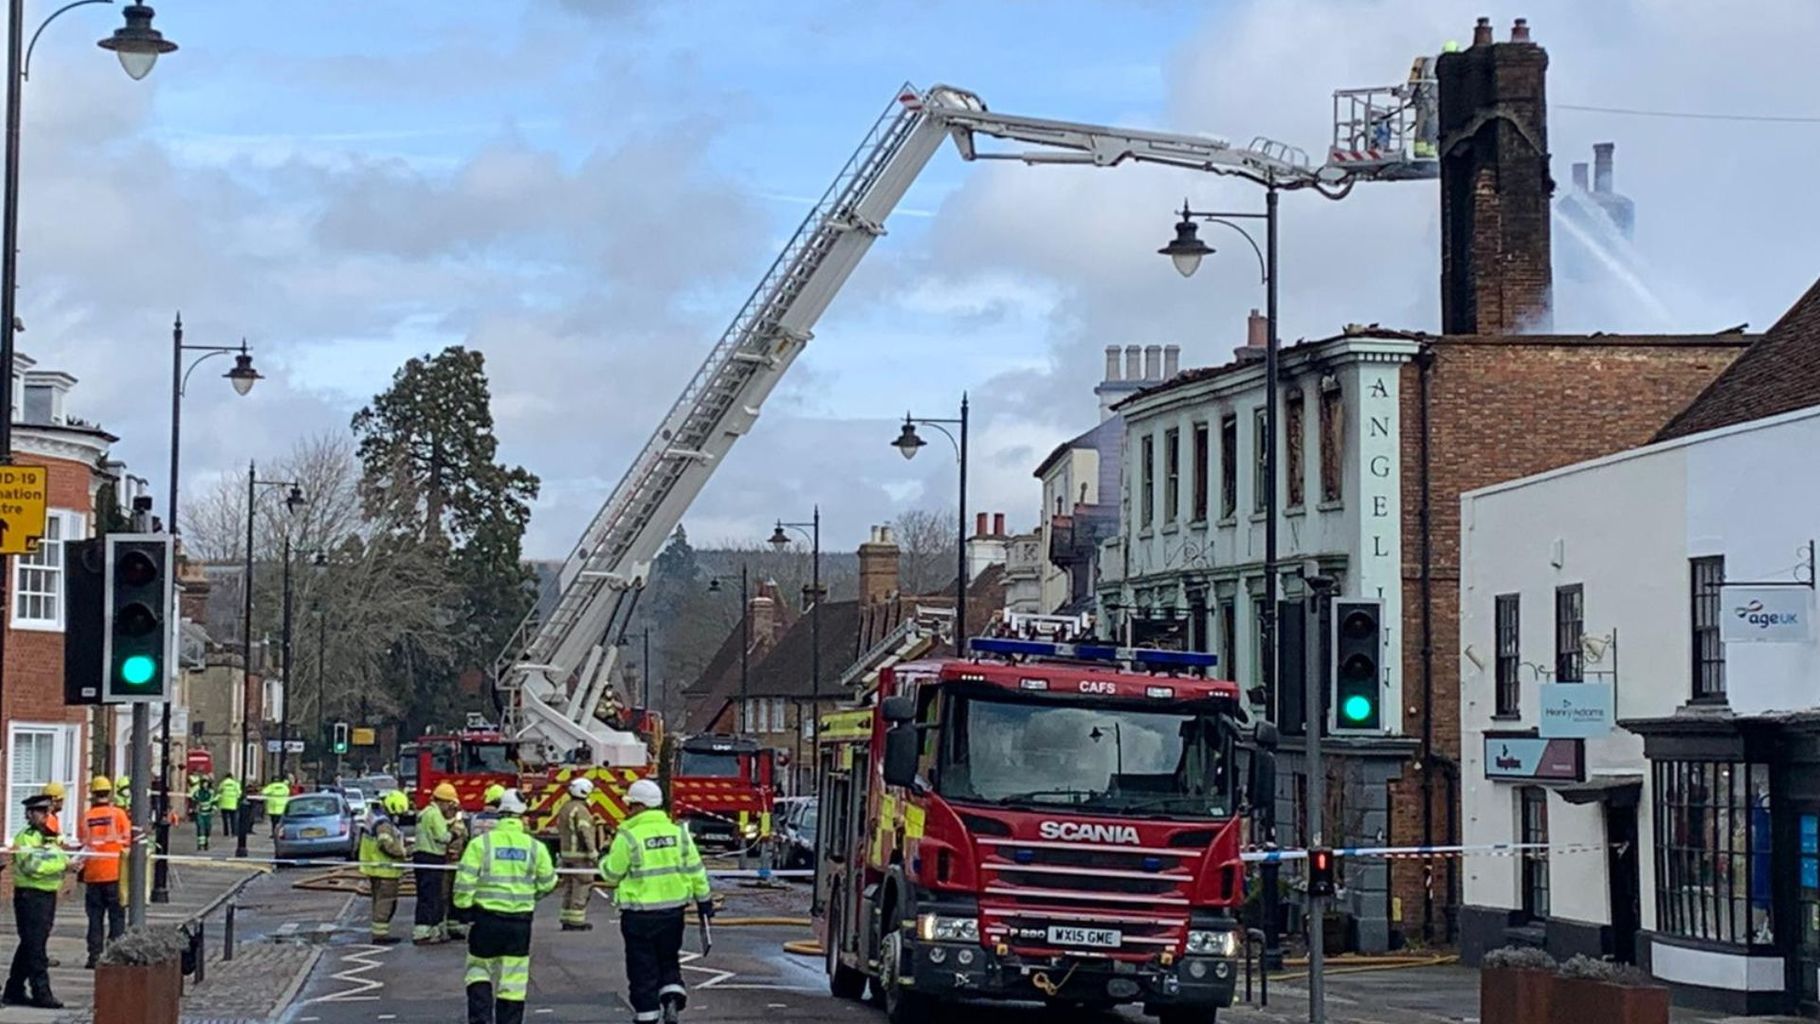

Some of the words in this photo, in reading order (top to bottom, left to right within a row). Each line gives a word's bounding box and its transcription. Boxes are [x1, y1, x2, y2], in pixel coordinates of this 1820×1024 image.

[1369, 377, 1390, 557] ANGEL
[1079, 680, 1116, 694] CAFS
[1040, 821, 1140, 844] SCANIA
[647, 837, 676, 848] GAS
